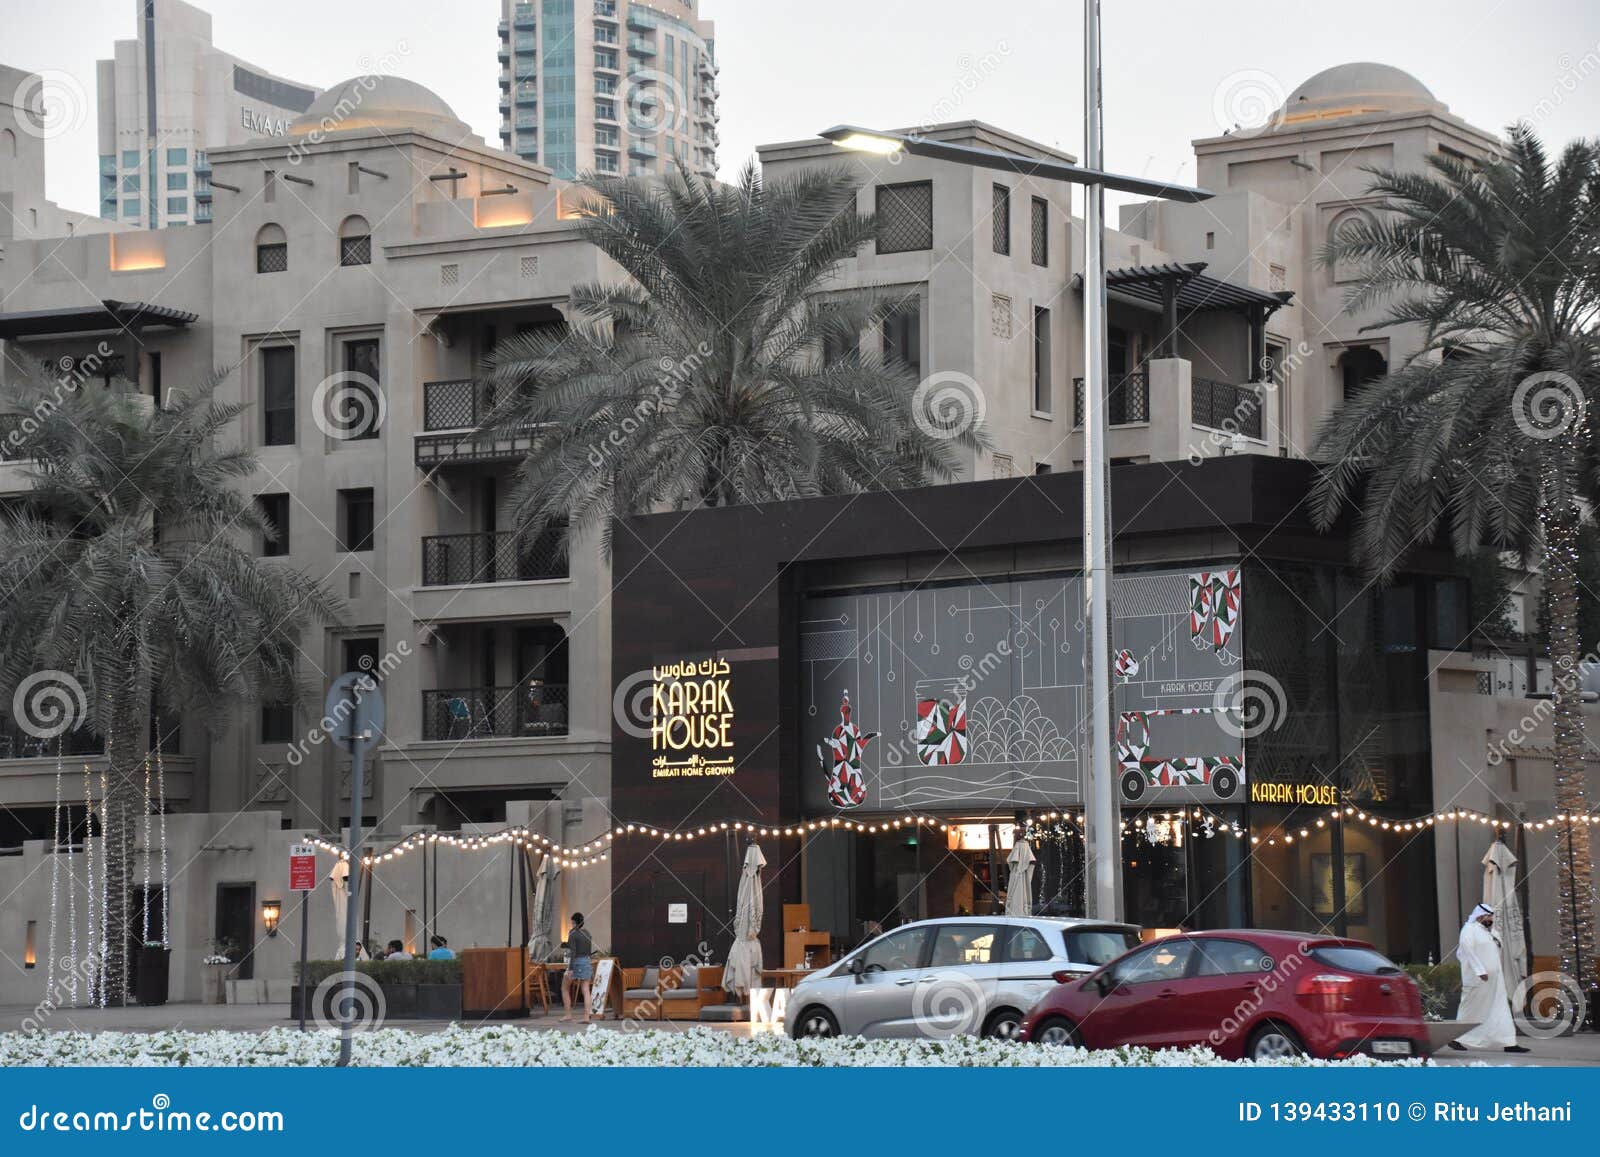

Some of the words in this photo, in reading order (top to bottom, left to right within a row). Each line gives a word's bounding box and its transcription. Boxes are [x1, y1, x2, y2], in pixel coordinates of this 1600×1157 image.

[653, 660, 697, 681] هاوس
[699, 657, 730, 678] كرك
[1160, 682, 1186, 693] KARAK
[1188, 680, 1214, 692] HOUSE
[653, 680, 734, 715] KARAK
[651, 713, 734, 750] HOUSE
[652, 768, 680, 777] EMIRATI
[682, 767, 703, 776] HOME
[705, 766, 735, 776] GROWN
[1252, 783, 1294, 803] KARAK
[1295, 784, 1338, 805] HOUSE
